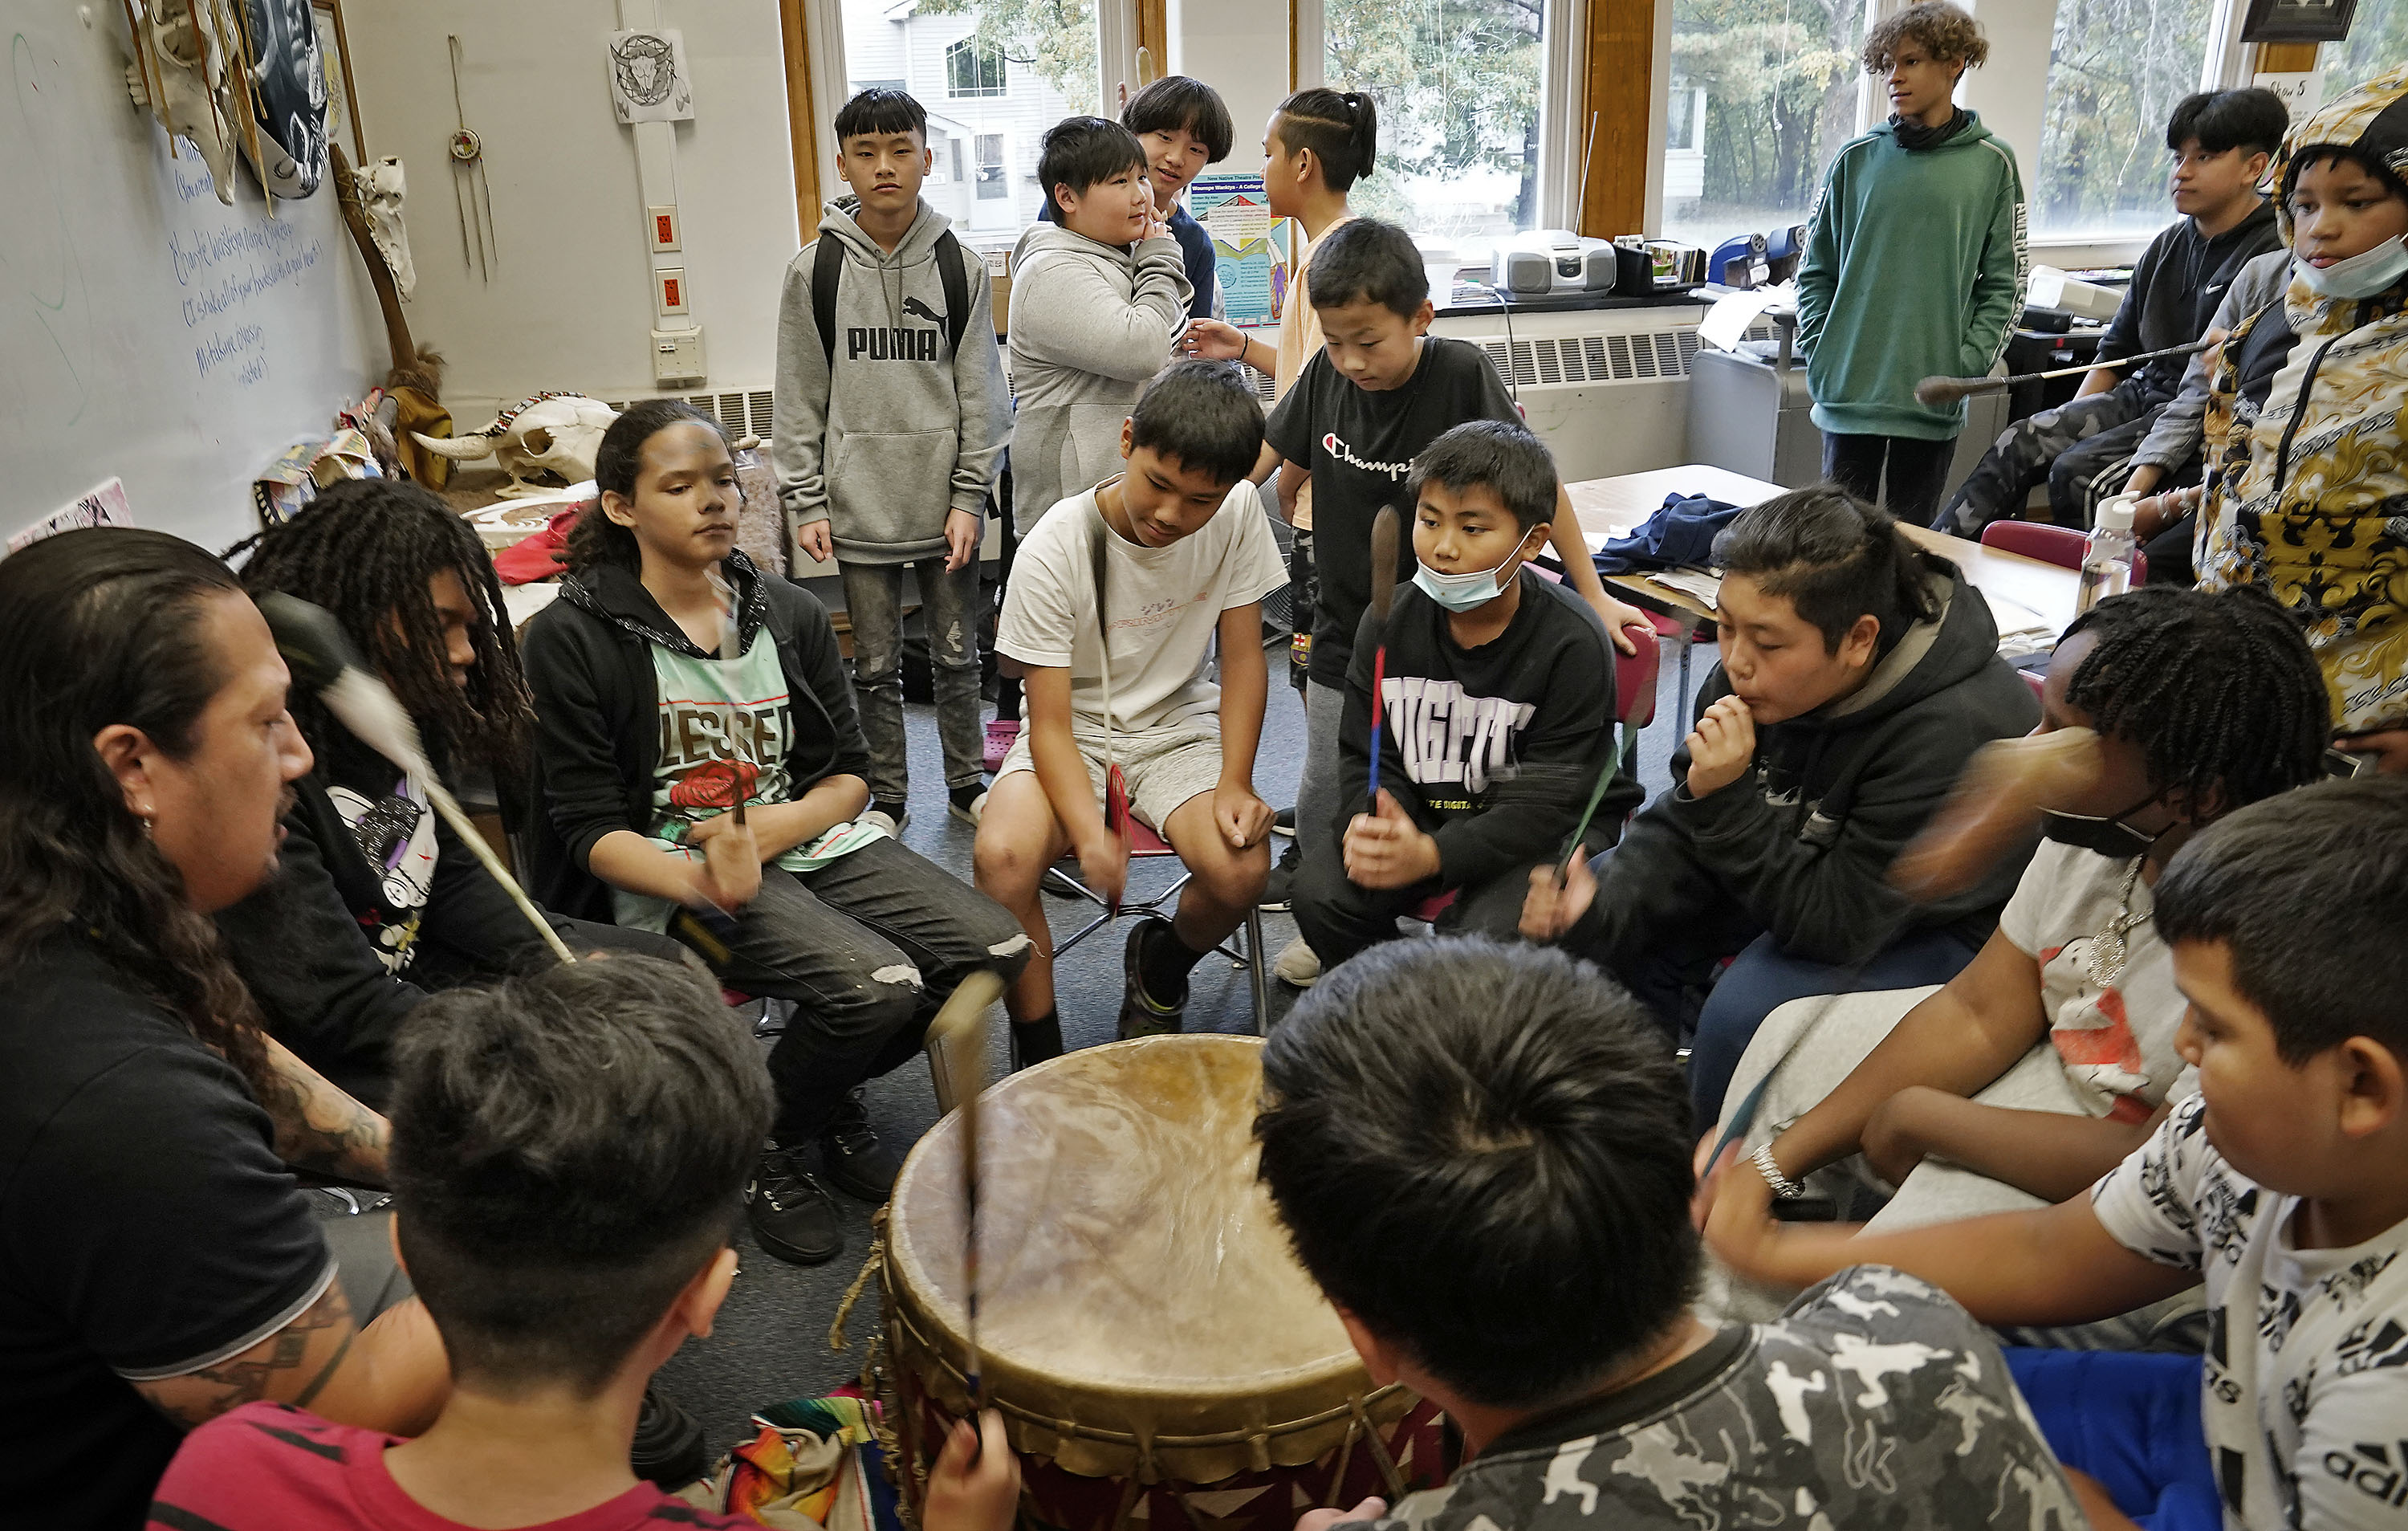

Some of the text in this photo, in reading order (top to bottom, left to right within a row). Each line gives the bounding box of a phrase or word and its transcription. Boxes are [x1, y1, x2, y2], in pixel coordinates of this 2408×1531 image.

[2296, 79, 2307, 96] 5
[2015, 202, 2029, 289] AMERICAN
[848, 328, 938, 361] PUMA
